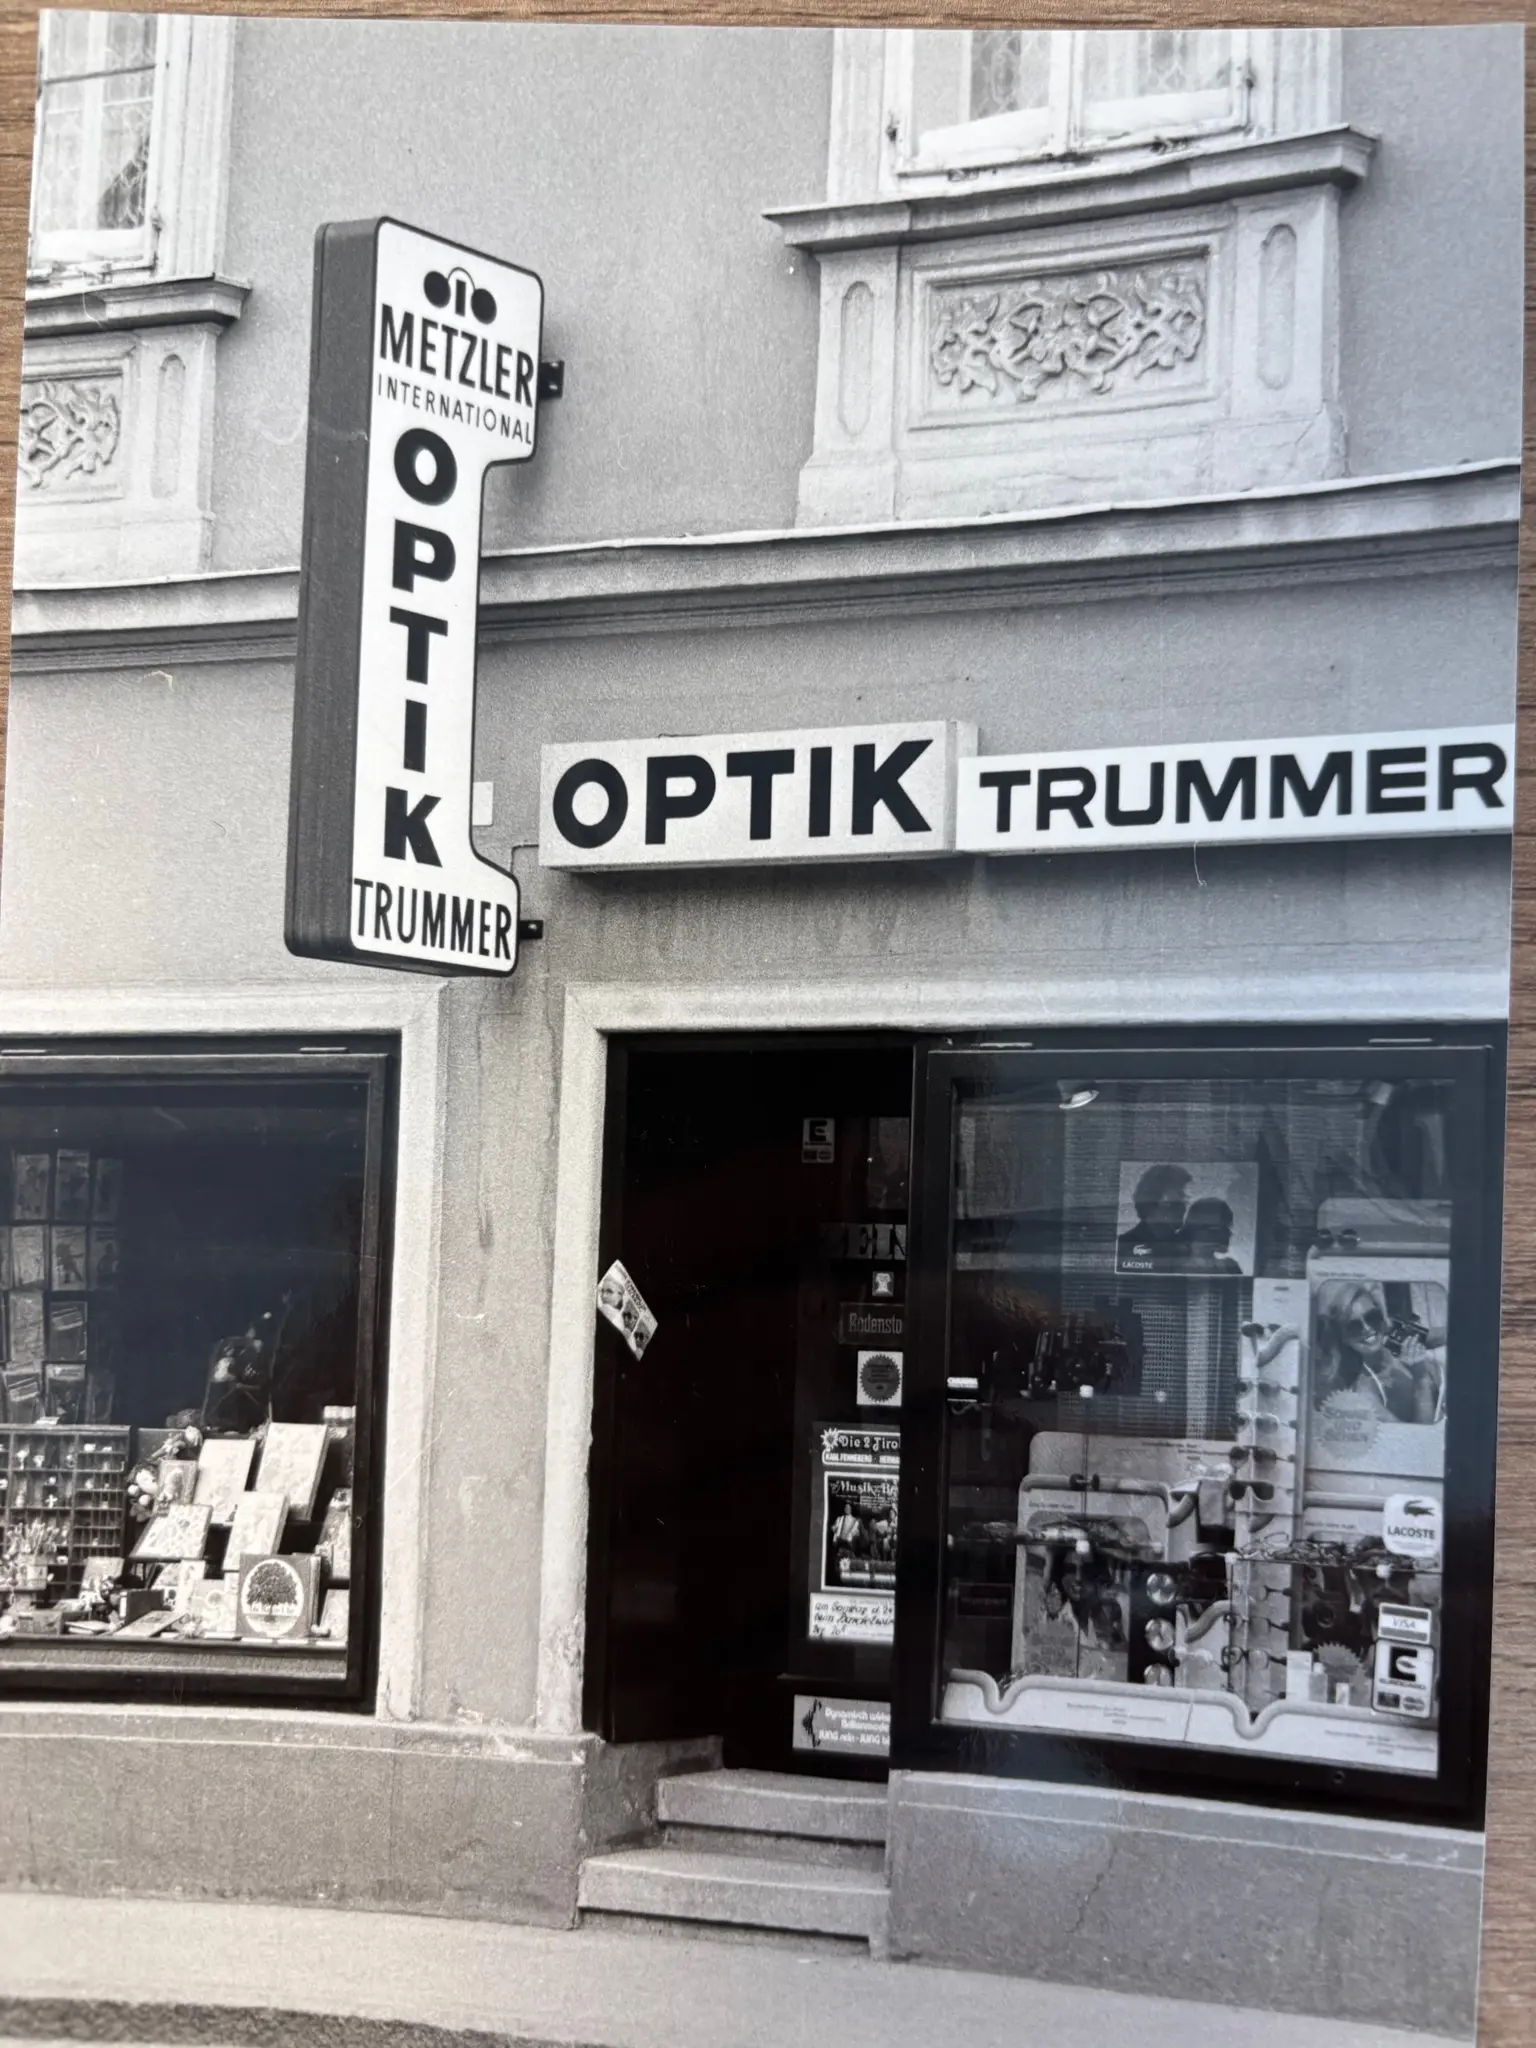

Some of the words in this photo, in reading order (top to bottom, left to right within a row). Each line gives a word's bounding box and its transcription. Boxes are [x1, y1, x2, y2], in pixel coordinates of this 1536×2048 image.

[379, 303, 534, 407] METZLER
[377, 374, 532, 445] INTERNATIONAL
[383, 428, 458, 868] OPTIK
[552, 738, 934, 849] OPTIK
[979, 742, 1507, 833] TRUMMER
[354, 878, 513, 960] TRUMMER
[1387, 1526, 1436, 1540] LACOSTE
[1392, 1616, 1417, 1629] VISA
